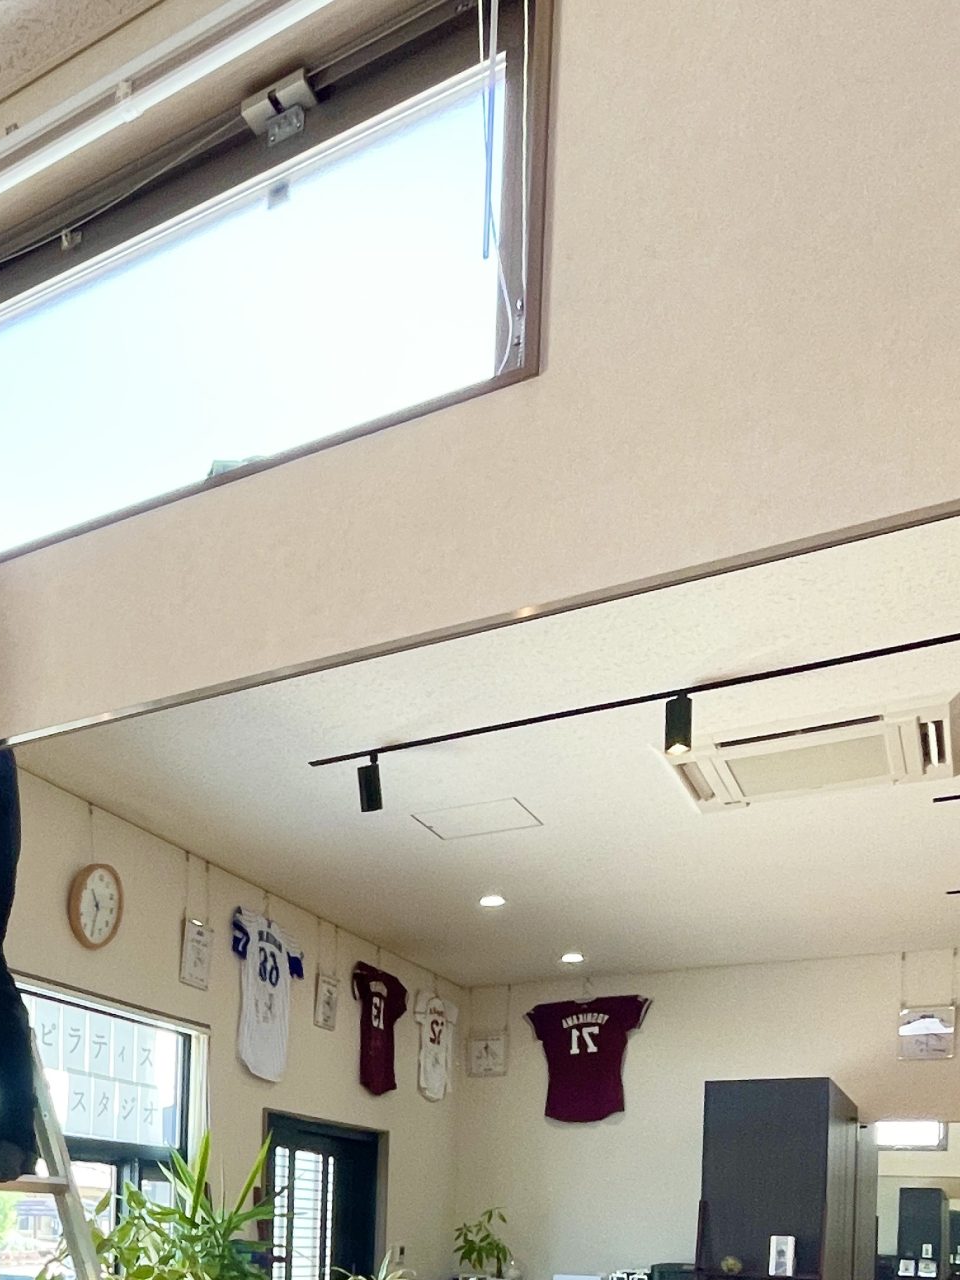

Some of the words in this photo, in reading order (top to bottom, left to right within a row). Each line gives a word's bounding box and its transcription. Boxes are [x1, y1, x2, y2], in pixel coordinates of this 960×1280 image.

[41, 1022, 154, 1068] ピラティス
[71, 1090, 159, 1127] スタジオ
